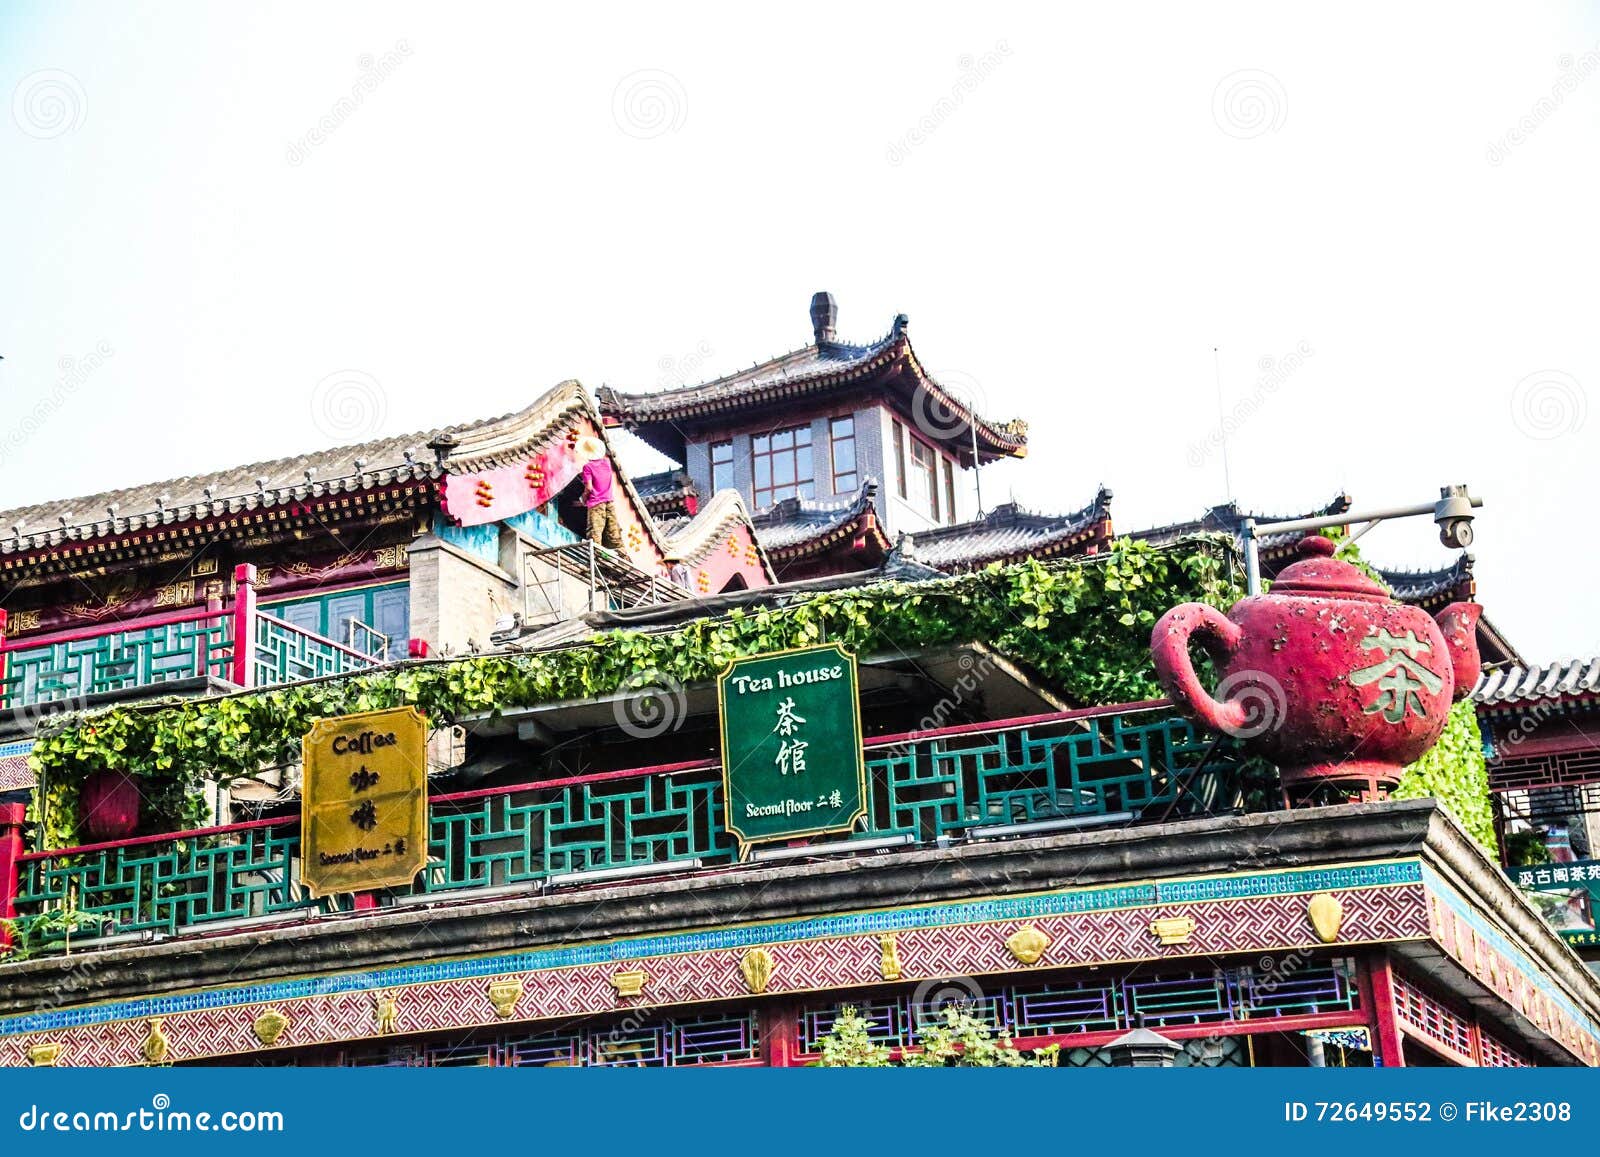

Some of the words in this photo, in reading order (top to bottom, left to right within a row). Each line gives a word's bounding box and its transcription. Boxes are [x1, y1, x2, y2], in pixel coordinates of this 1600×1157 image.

[732, 675, 774, 694] Tea
[778, 665, 843, 689] house
[1350, 627, 1442, 724] 茶
[332, 731, 398, 755] Coffee
[773, 697, 809, 775] 茶馆
[746, 800, 785, 818] Second
[786, 800, 813, 816] floor
[816, 789, 843, 809] 二楼
